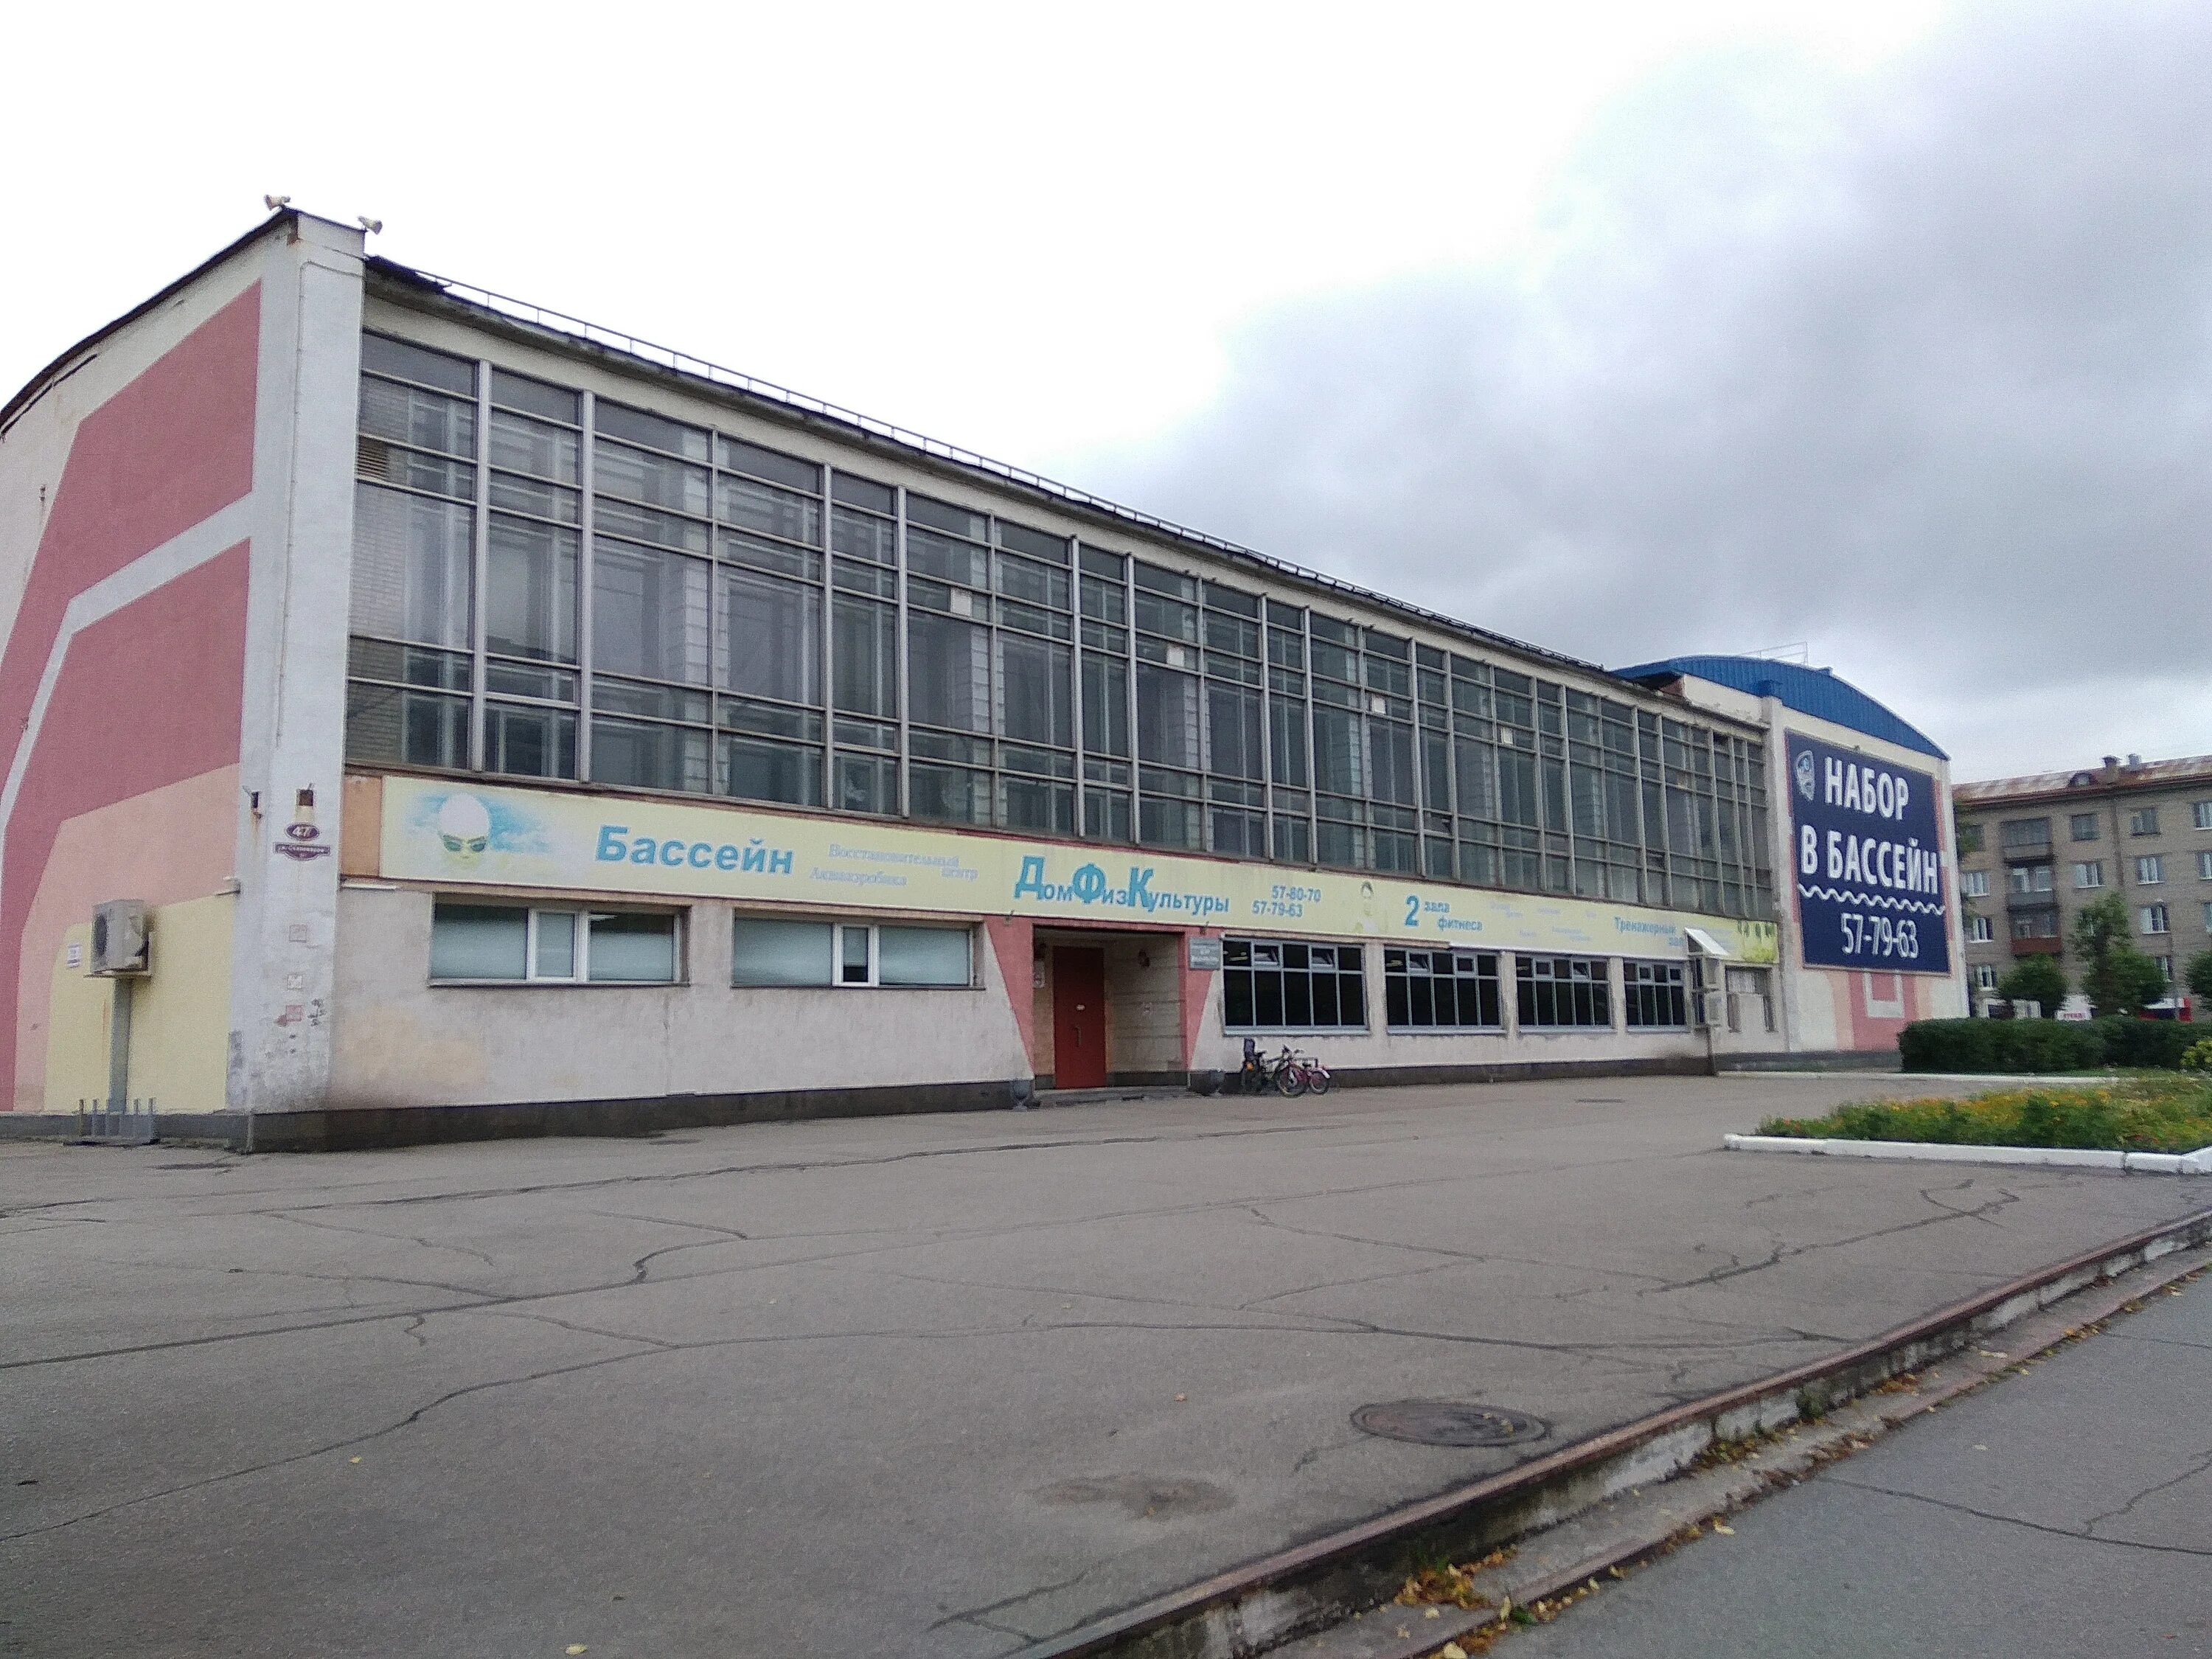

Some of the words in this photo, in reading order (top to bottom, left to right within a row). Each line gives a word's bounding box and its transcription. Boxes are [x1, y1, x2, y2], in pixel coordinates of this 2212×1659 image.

[1823, 756, 1910, 821] НАБОР
[595, 824, 794, 875] Бассейн
[1801, 824, 1818, 875] В
[1826, 829, 1938, 894] БАССЕЙН
[1251, 900, 1303, 918] 57-79-63
[1405, 894, 1419, 927] 2
[1423, 900, 1450, 914] зала
[1437, 915, 1484, 932] фитнеса
[1841, 912, 1919, 959] 57-79-63
